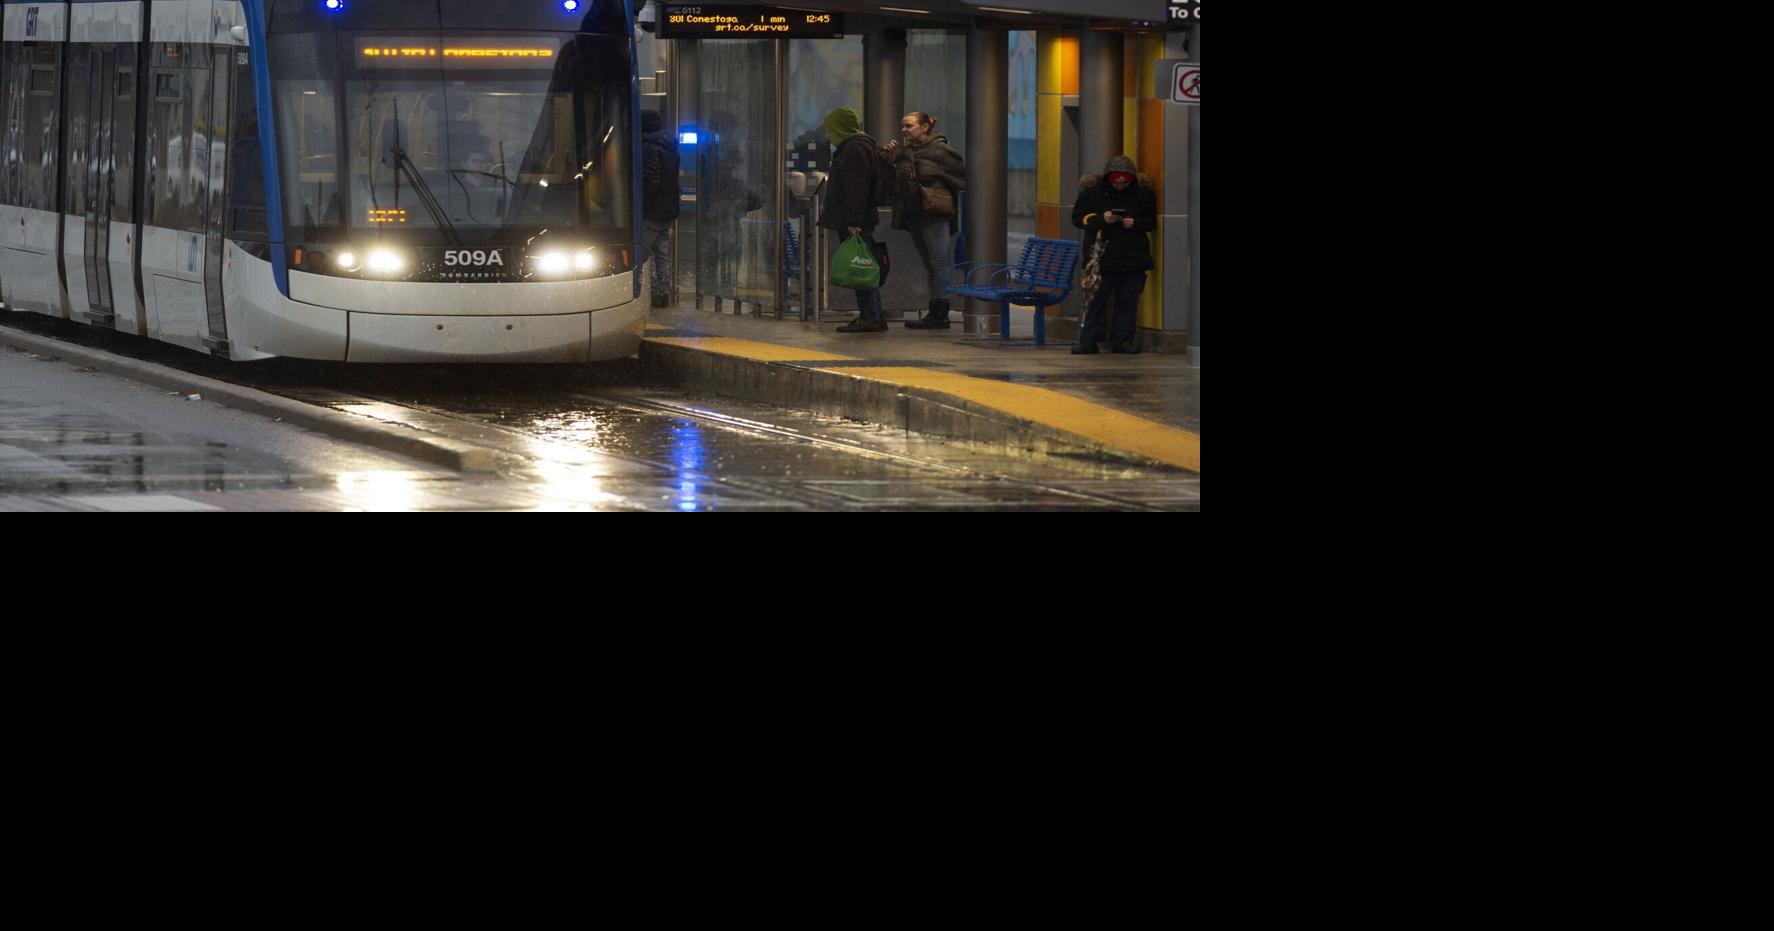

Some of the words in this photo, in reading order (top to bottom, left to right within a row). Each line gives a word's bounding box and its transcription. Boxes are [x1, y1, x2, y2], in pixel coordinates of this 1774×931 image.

[1168, 6, 1189, 19] To
[669, 15, 684, 23] 301
[686, 15, 739, 23] Conestoga
[806, 15, 830, 23] 12:45
[715, 23, 789, 32] grt.ca/survey
[444, 250, 504, 266] 509A
